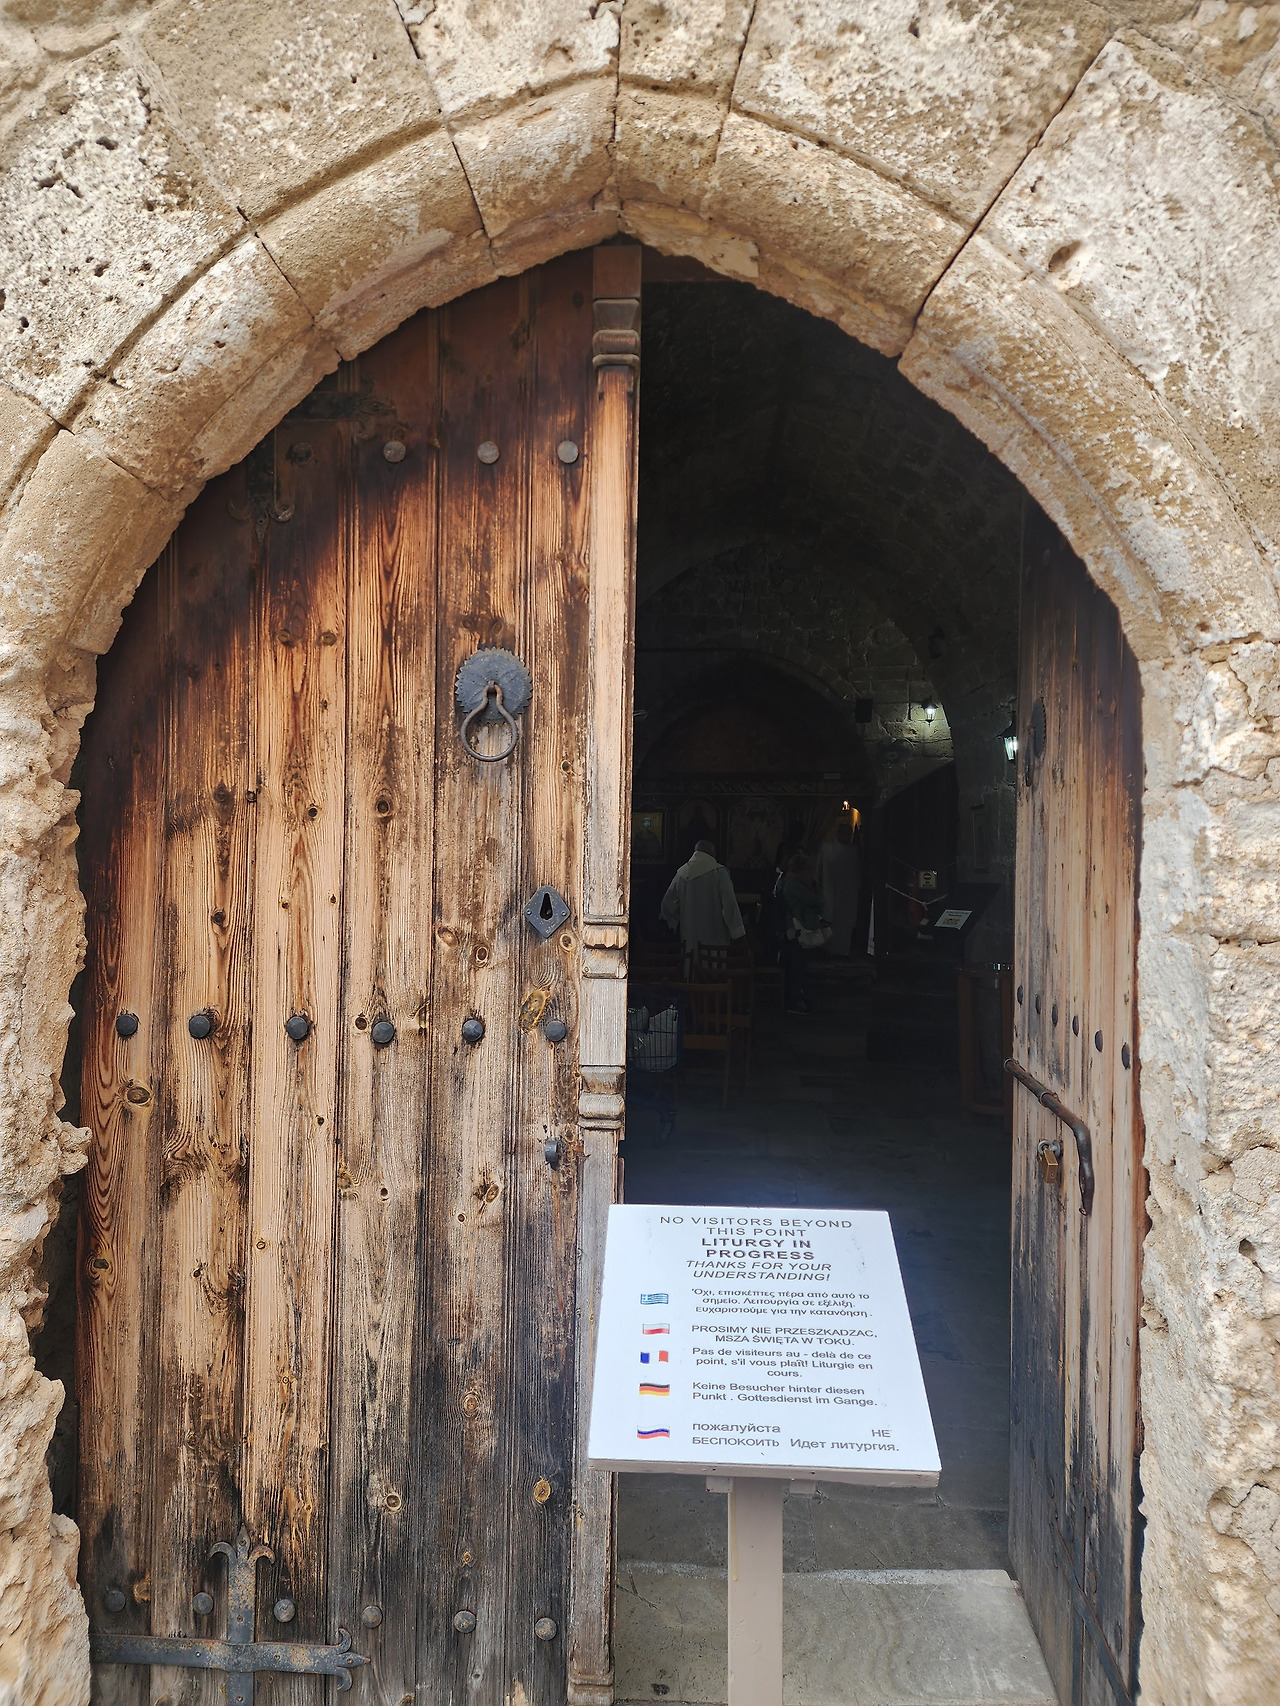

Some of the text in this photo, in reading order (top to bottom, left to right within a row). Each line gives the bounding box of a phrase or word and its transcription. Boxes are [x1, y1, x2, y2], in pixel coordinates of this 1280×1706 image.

[660, 1216, 852, 1229] NO VISITORS BEYOND
[706, 1227, 807, 1237] THIS POINT
[701, 1237, 811, 1249] LITURGY IN
[706, 1249, 815, 1261] PROGRESS
[686, 1260, 832, 1272] THANKS FOR YOUR
[693, 1270, 831, 1282] UNDERSTANDING!
[777, 1290, 805, 1299] πέρα
[743, 1297, 800, 1307] Λειτουργία
[695, 1306, 768, 1315] Ευχαριστούμε
[691, 1325, 748, 1334] PROSIMY
[751, 1326, 772, 1335] NIE
[715, 1334, 750, 1343] MSZA
[752, 1334, 800, 1346] ŚWIĘTA
[816, 1337, 855, 1346] TOKU.
[692, 1347, 715, 1356] Pas
[717, 1348, 732, 1356] de
[735, 1348, 783, 1357] visiteurs
[811, 1350, 837, 1359] delà
[839, 1351, 854, 1360] de
[696, 1357, 728, 1366] point,
[811, 1360, 855, 1371] Liturgie
[692, 1382, 865, 1395] Keine Besucher hinter diesen
[692, 1392, 727, 1401] Punkt
[737, 1393, 813, 1404] Gottesdienst
[815, 1395, 830, 1404] im
[833, 1396, 878, 1408] Gange.
[692, 1422, 890, 1438] пожалуйста НЕ
[790, 1438, 827, 1450] Идет
[830, 1441, 899, 1452] литургия.
